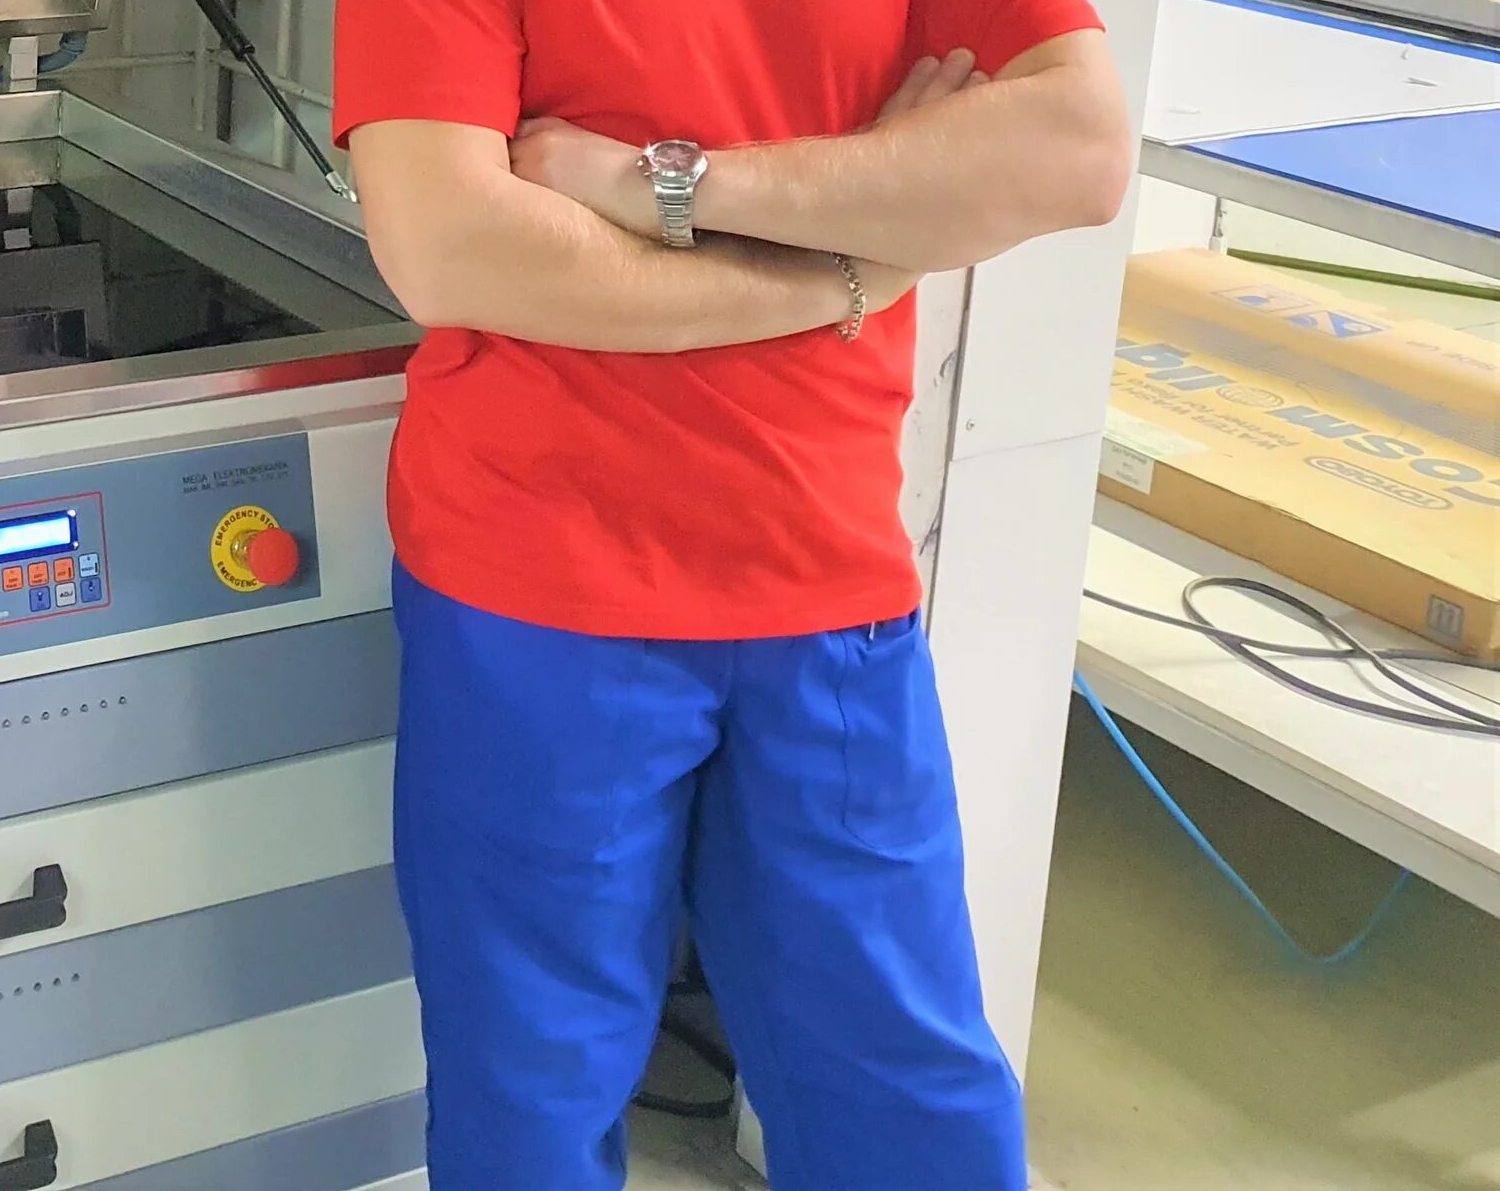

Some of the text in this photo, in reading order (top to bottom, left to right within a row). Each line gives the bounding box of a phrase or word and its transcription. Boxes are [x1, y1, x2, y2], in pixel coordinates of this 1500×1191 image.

[215, 509, 275, 546] EMERGENCY STO
[217, 561, 258, 588] EMERGENC
